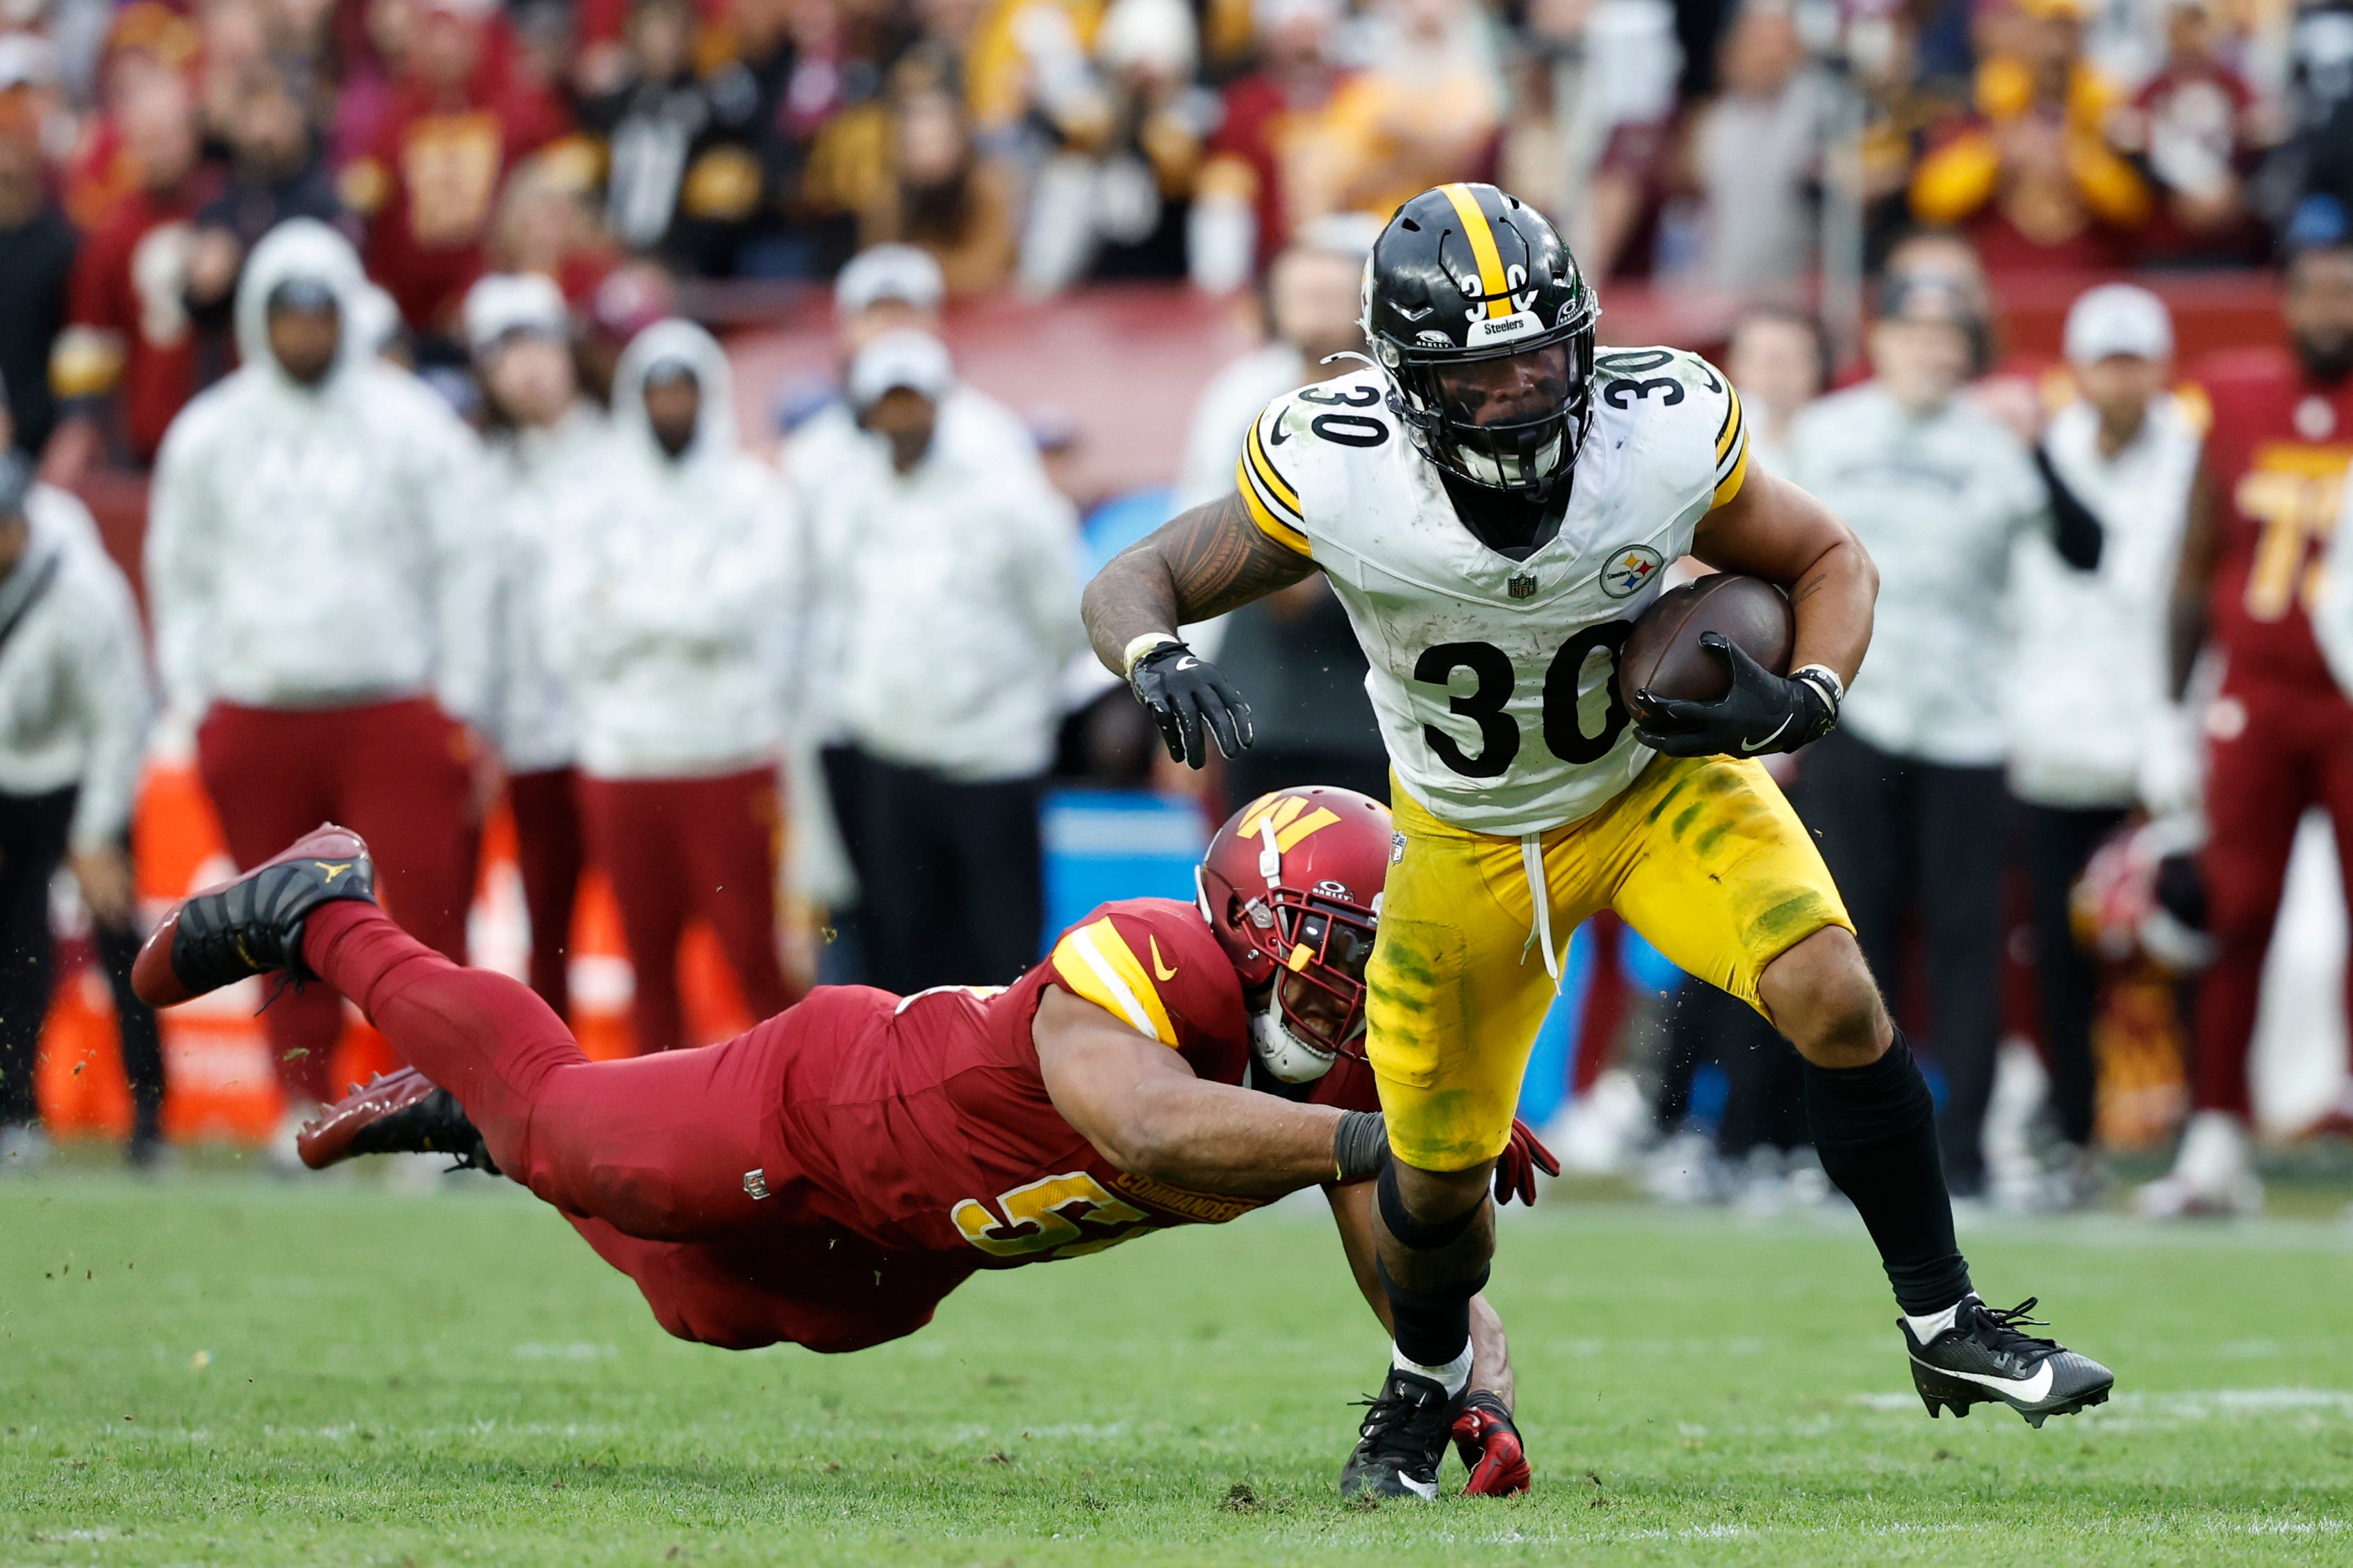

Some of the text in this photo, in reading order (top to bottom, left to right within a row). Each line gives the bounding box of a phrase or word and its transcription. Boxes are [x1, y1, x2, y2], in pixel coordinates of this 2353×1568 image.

[1484, 319, 1525, 335] Steelers
[1595, 350, 1684, 409] 30
[1298, 386, 1389, 447] 30
[1607, 570, 1631, 580] Steelers
[1512, 585, 1534, 597] NFL
[1414, 619, 1634, 778] 30
[1312, 888, 1350, 900] OAKLEY
